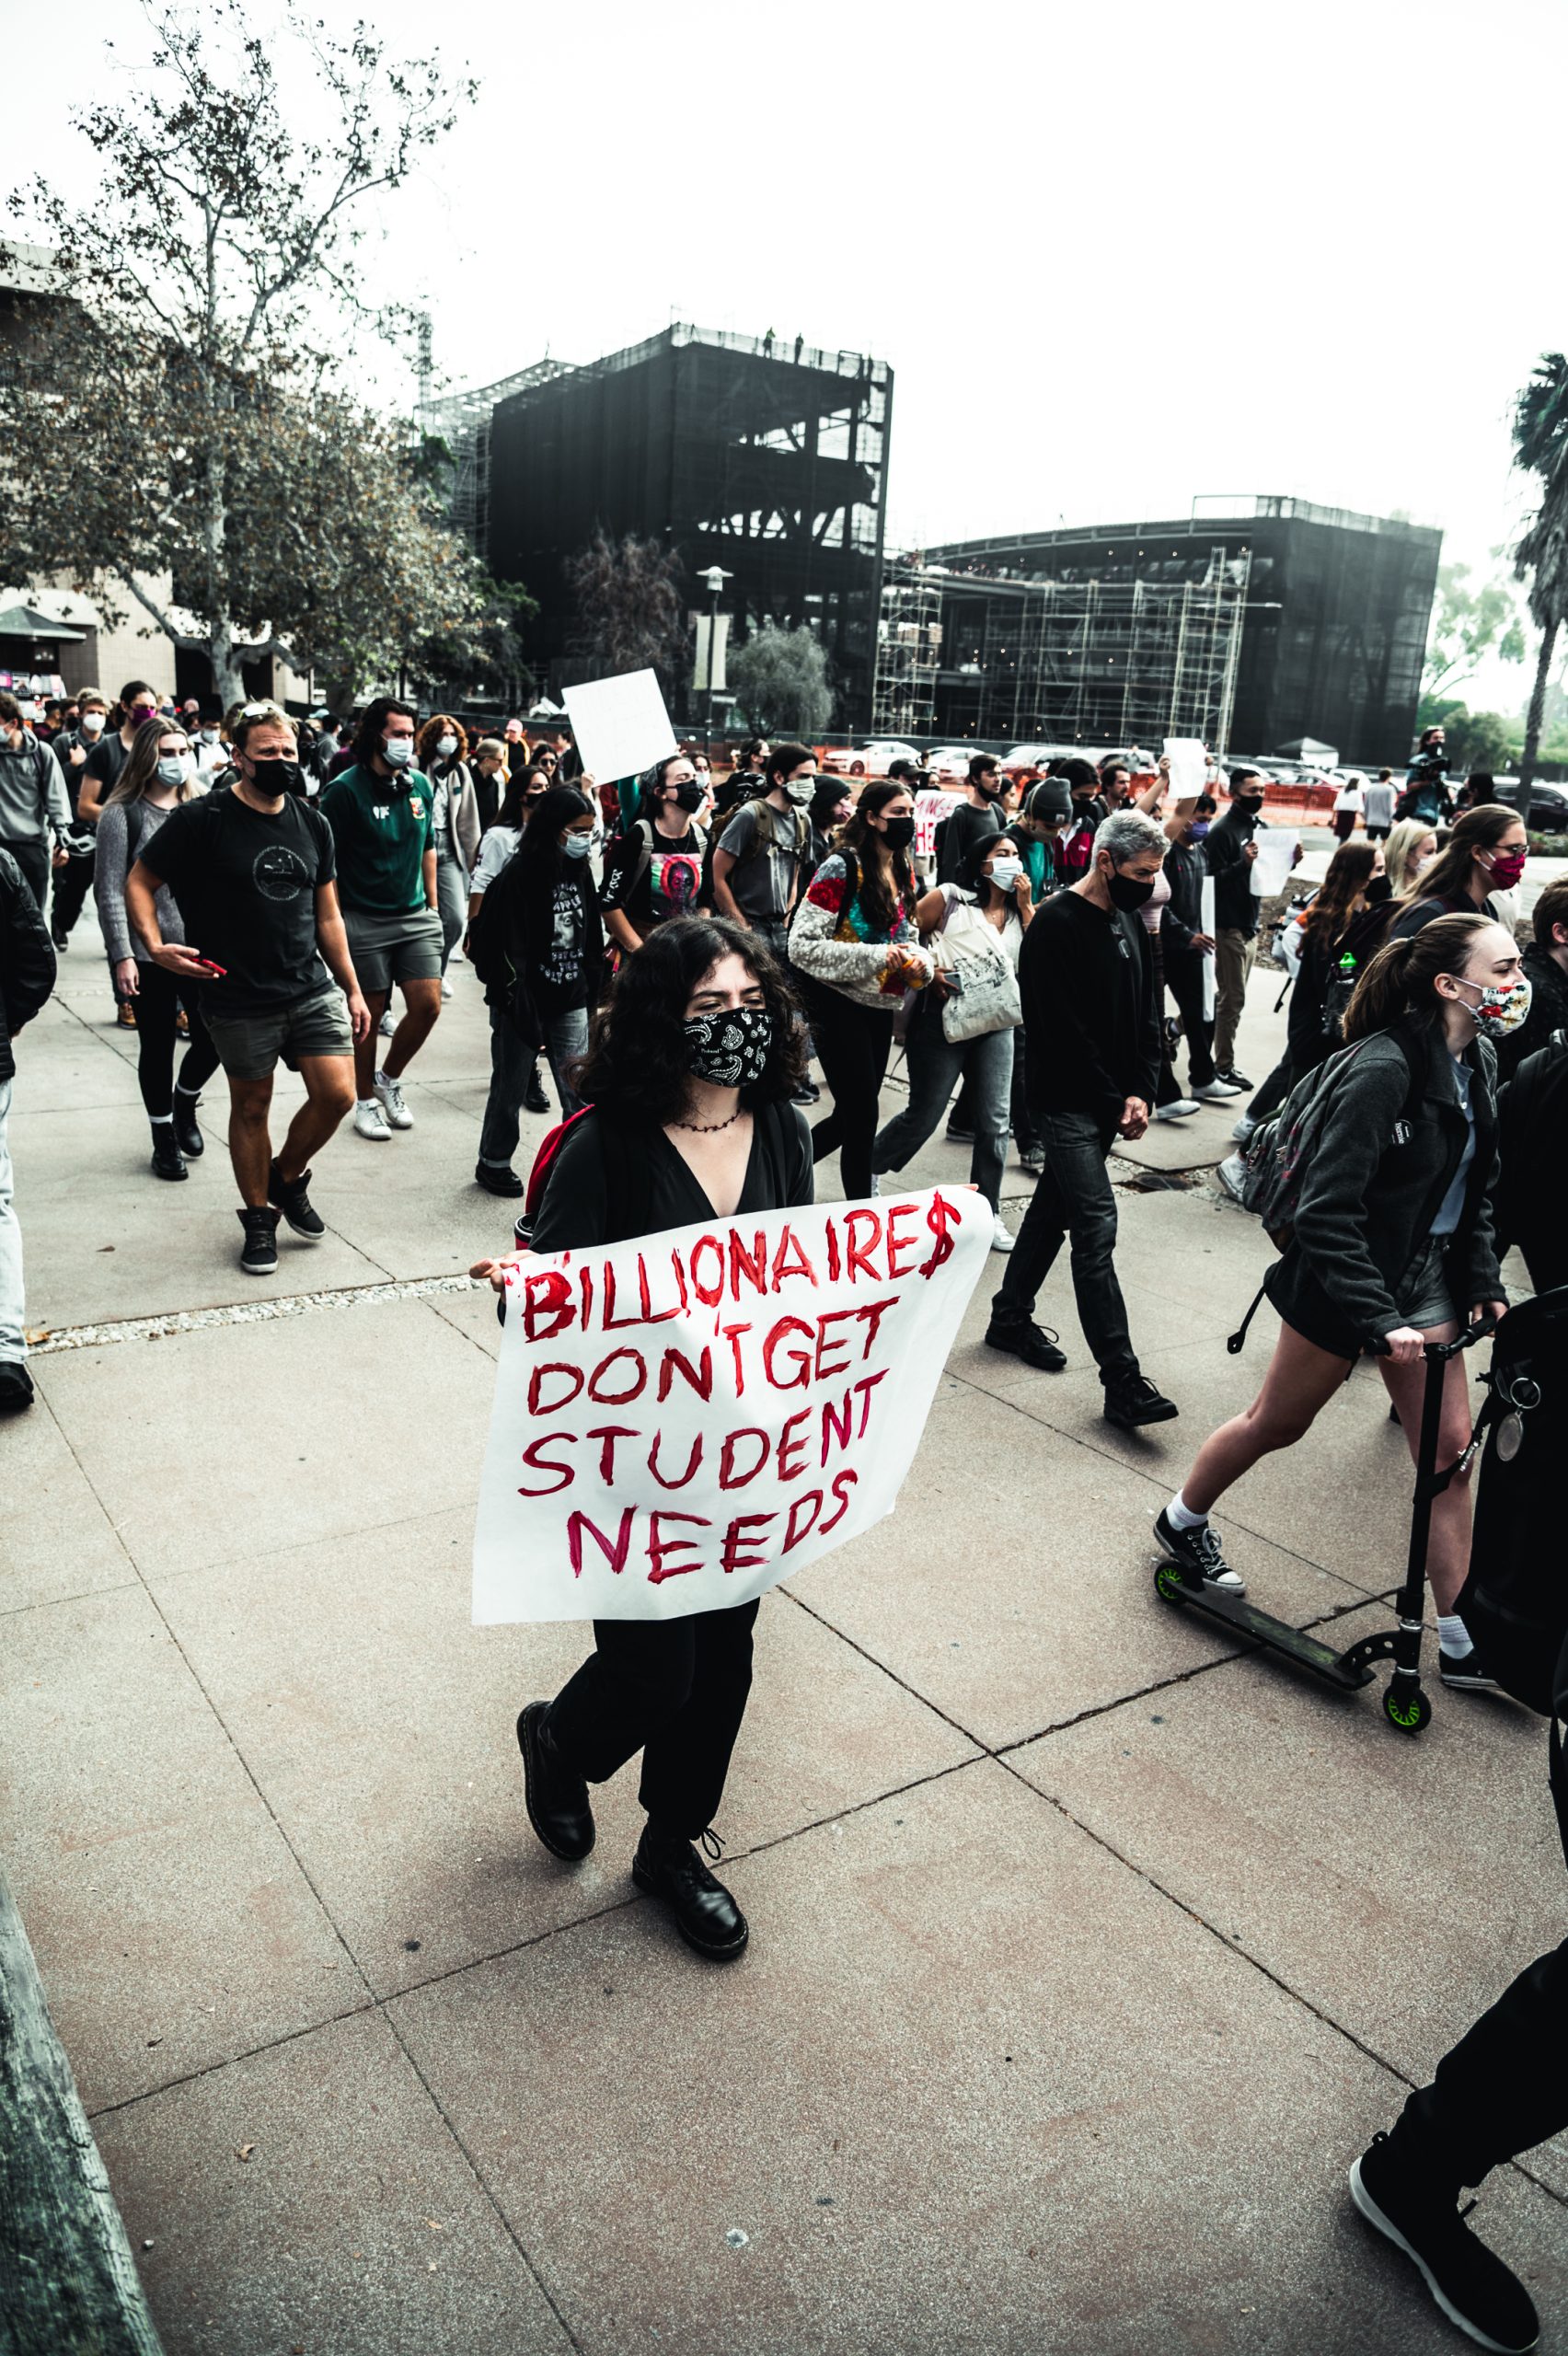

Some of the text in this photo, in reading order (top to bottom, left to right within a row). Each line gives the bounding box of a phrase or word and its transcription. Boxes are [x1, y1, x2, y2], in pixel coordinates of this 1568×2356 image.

[522, 1190, 963, 1343] BILLIONAIRE$
[527, 1296, 900, 1416] DON'T GET
[518, 1369, 891, 1497] STUDENT
[566, 1468, 859, 1584] NEEDS
